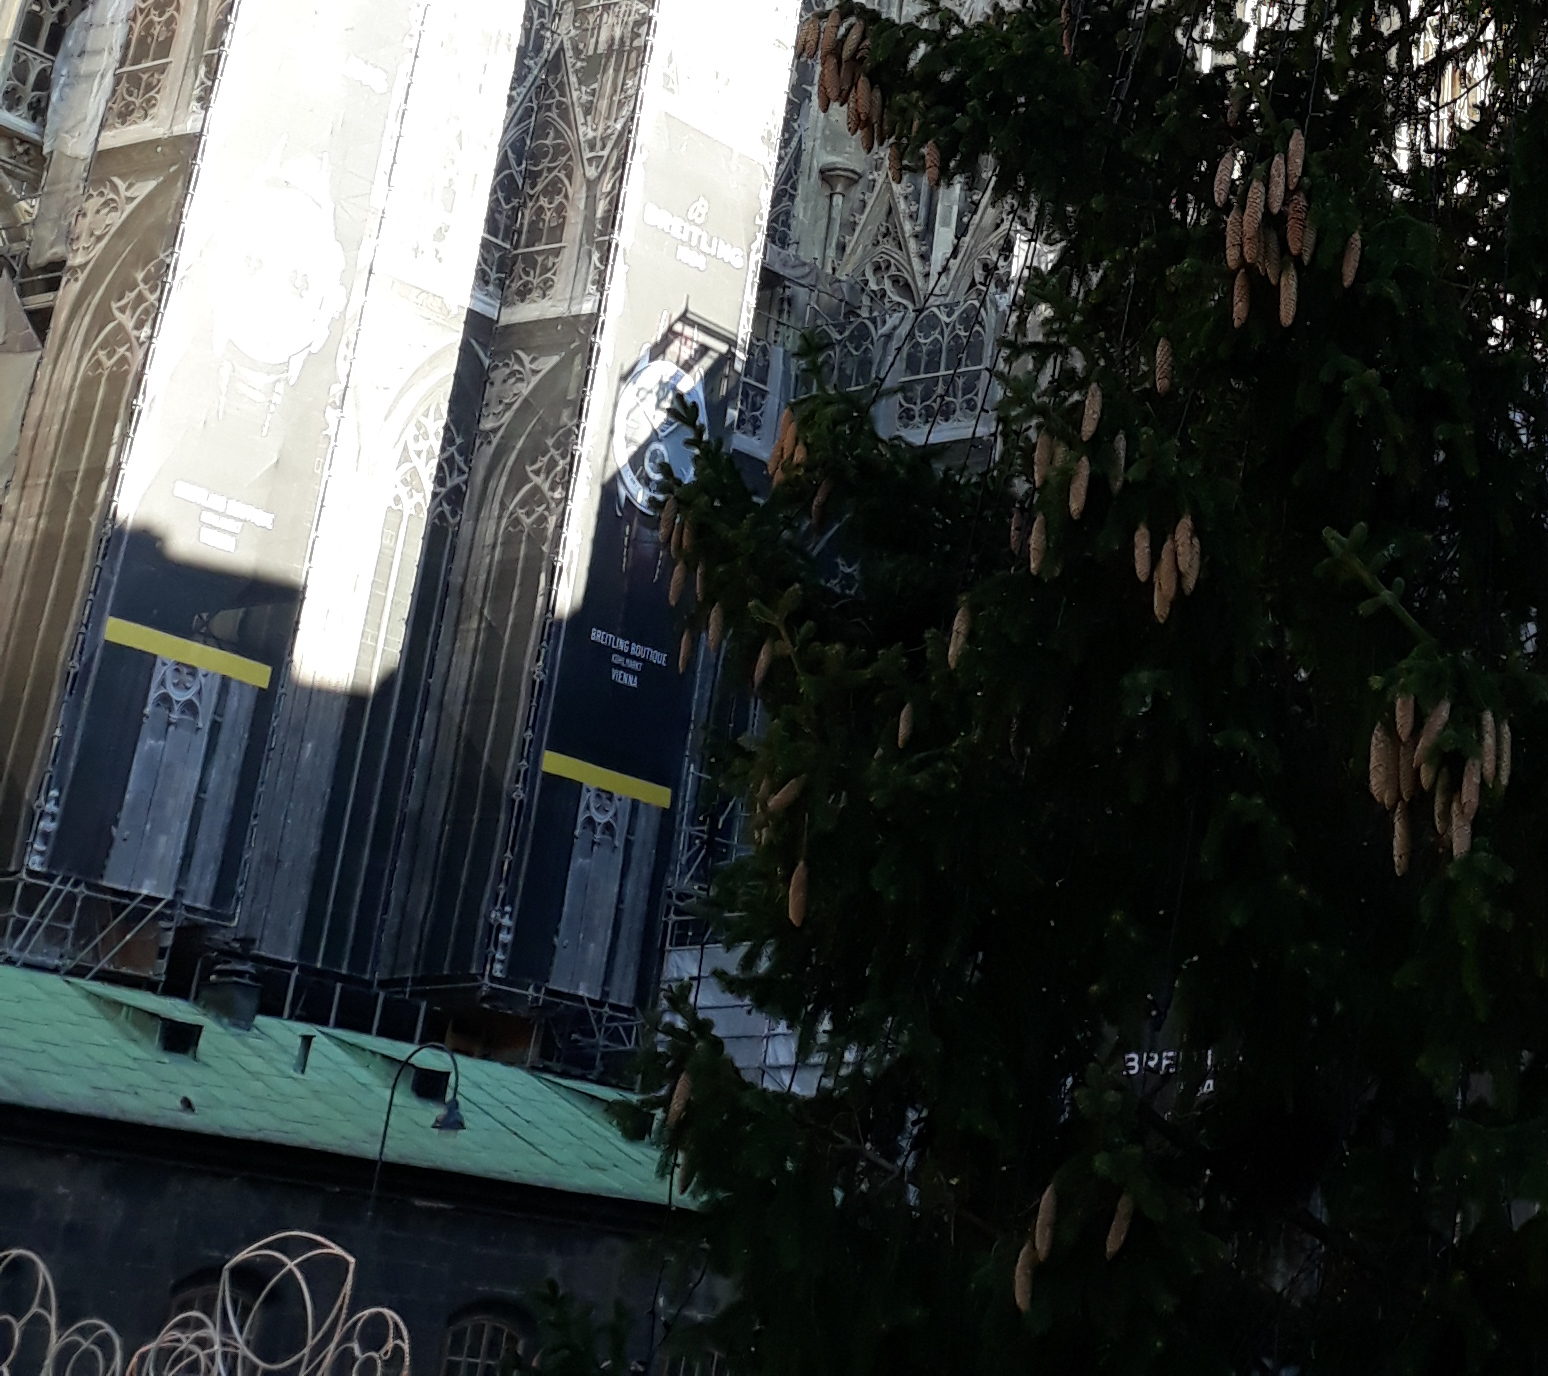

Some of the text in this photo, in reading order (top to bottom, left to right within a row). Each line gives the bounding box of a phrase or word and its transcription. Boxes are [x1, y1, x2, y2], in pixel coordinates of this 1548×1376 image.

[590, 627, 668, 667] BREITLING BOUTIQUE
[611, 667, 638, 688] VIENNA
